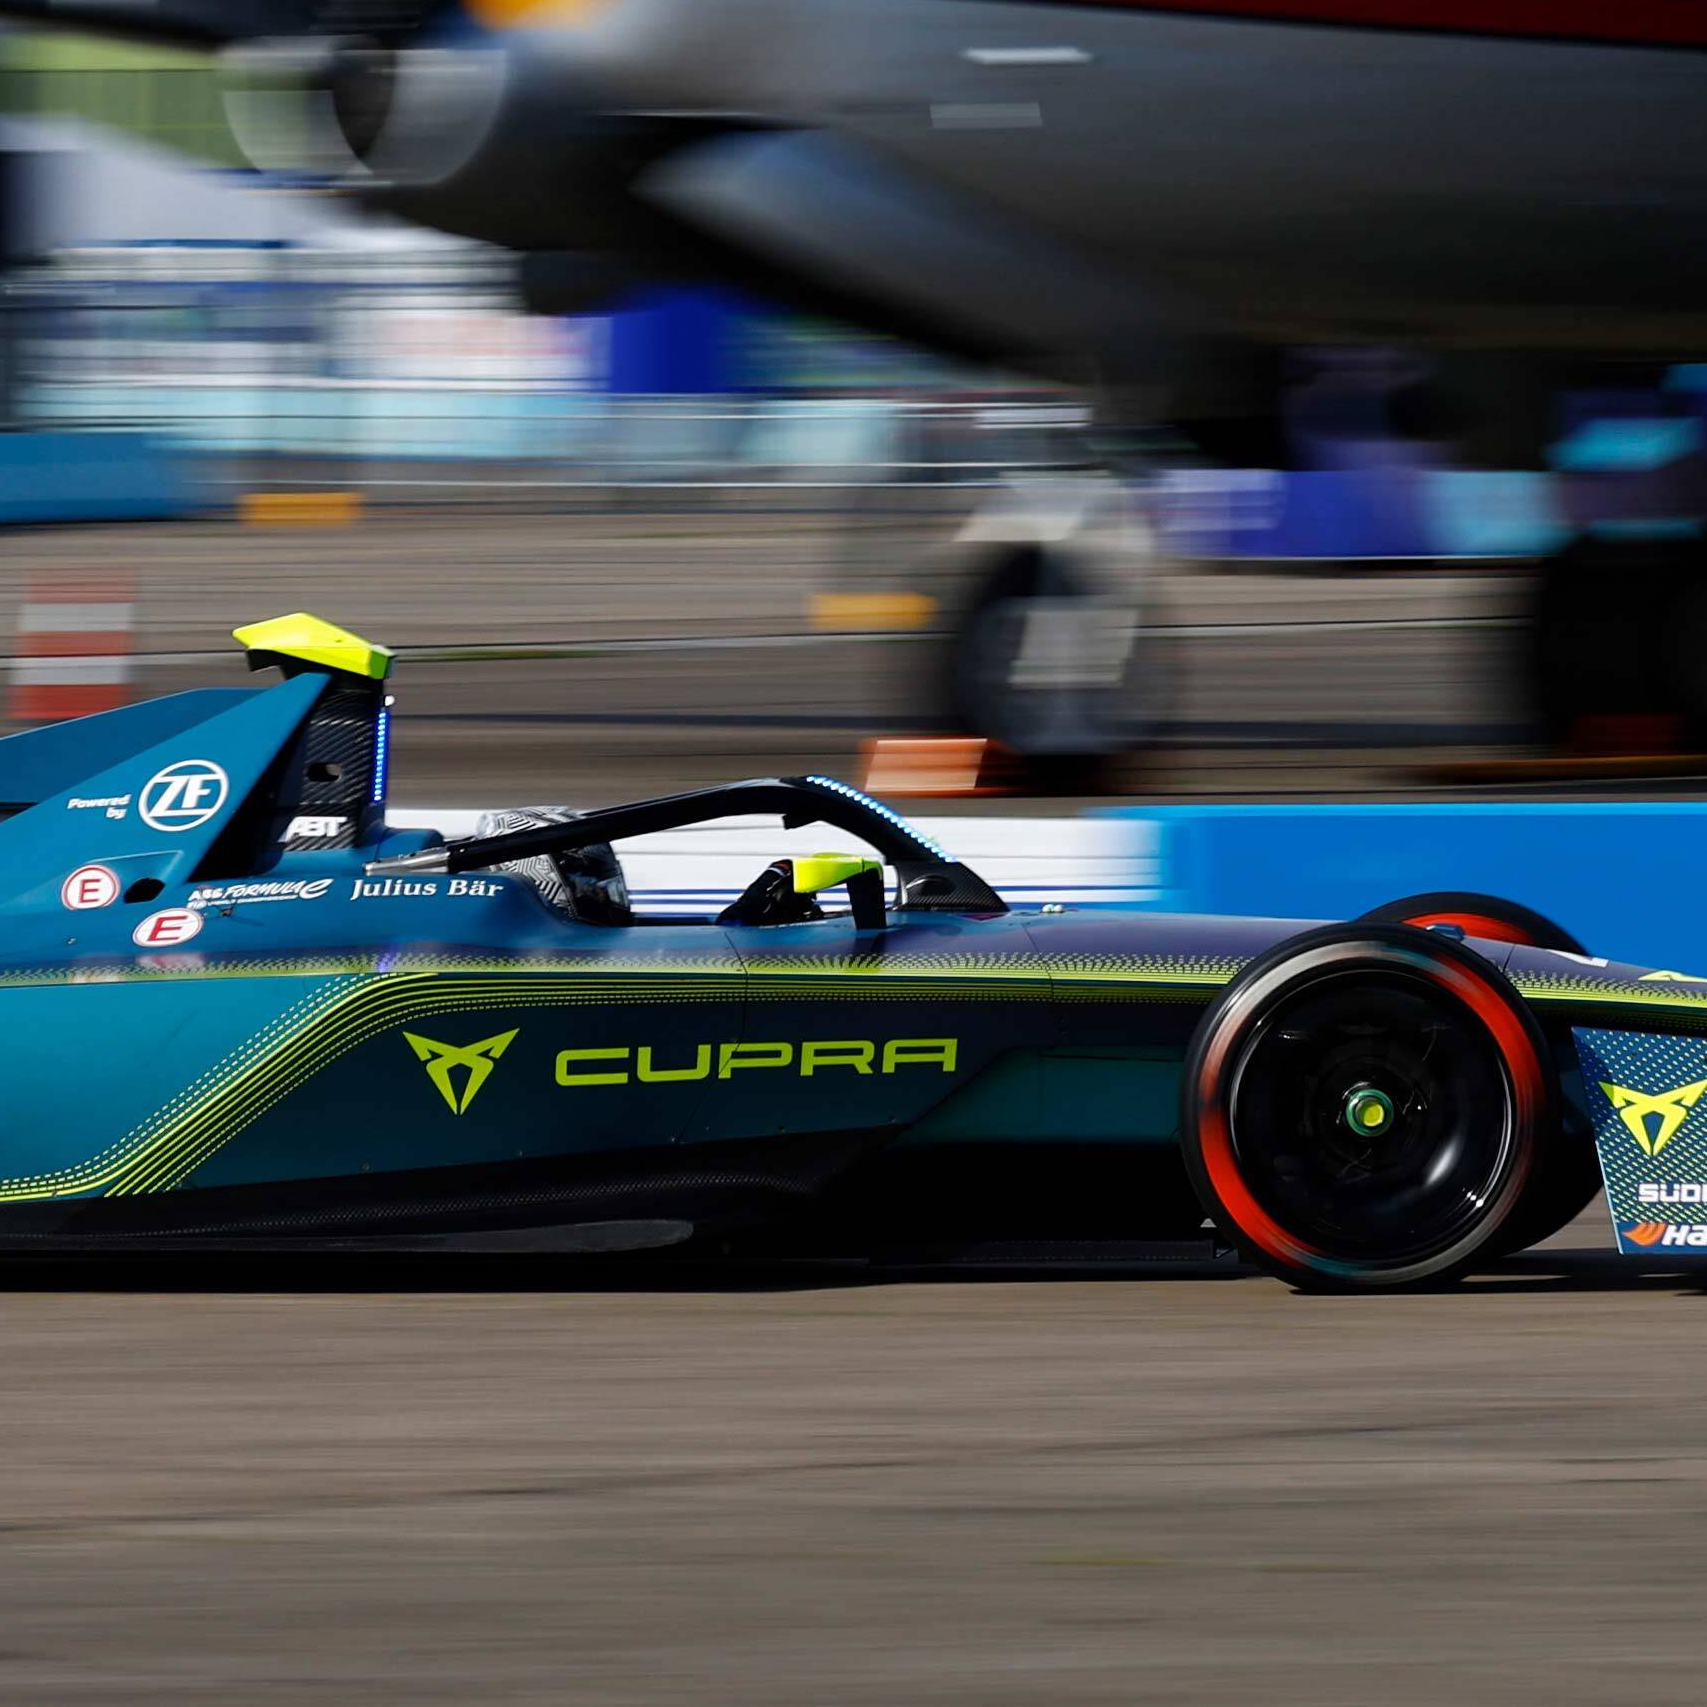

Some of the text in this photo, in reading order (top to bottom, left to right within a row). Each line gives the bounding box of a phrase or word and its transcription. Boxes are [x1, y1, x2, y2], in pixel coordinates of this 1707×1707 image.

[67, 794, 132, 809] Powered
[148, 774, 224, 817] ZF
[106, 807, 127, 819] by
[278, 816, 348, 843] ABT
[78, 878, 102, 903] E
[350, 878, 505, 901] Julius Bär
[147, 915, 189, 942] E
[555, 1038, 958, 1087] CUPRA
